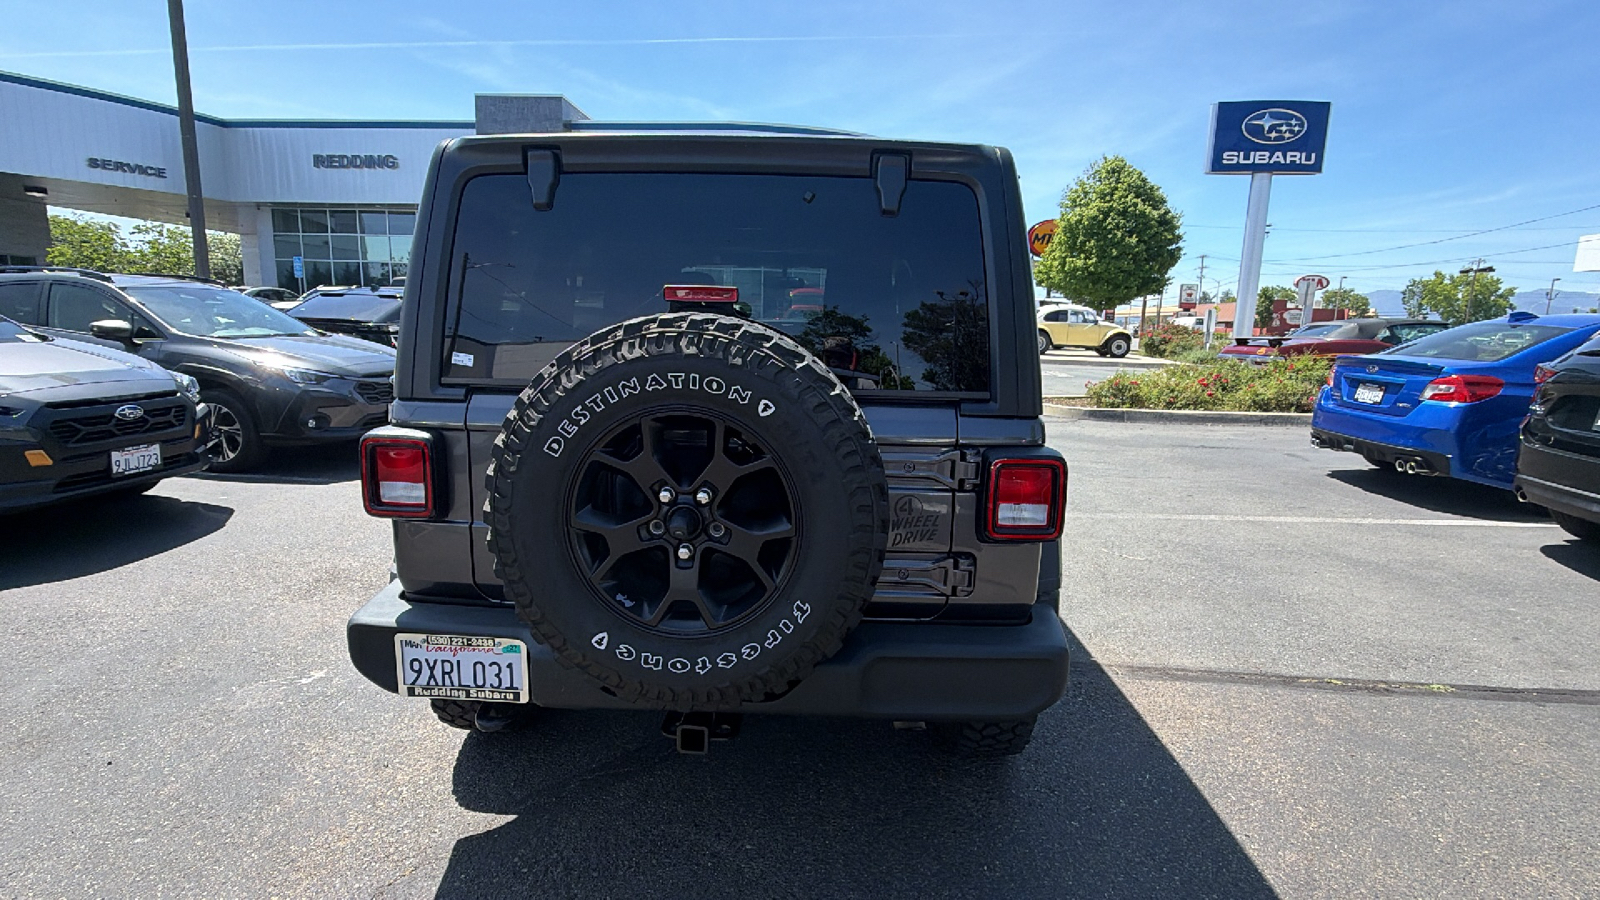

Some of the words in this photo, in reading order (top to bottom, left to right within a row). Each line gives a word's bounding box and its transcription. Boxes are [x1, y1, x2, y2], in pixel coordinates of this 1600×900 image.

[313, 154, 399, 169] REDDING
[1221, 150, 1316, 166] SUBARU
[87, 157, 167, 179] SERVICE
[543, 372, 752, 458] DESTINATION
[891, 514, 940, 533] WHEEL
[891, 528, 939, 547] DRIVE
[427, 636, 450, 646] (530)
[409, 658, 519, 690] 9XRL031
[415, 687, 466, 699] Redding
[470, 689, 514, 700] Subaru
